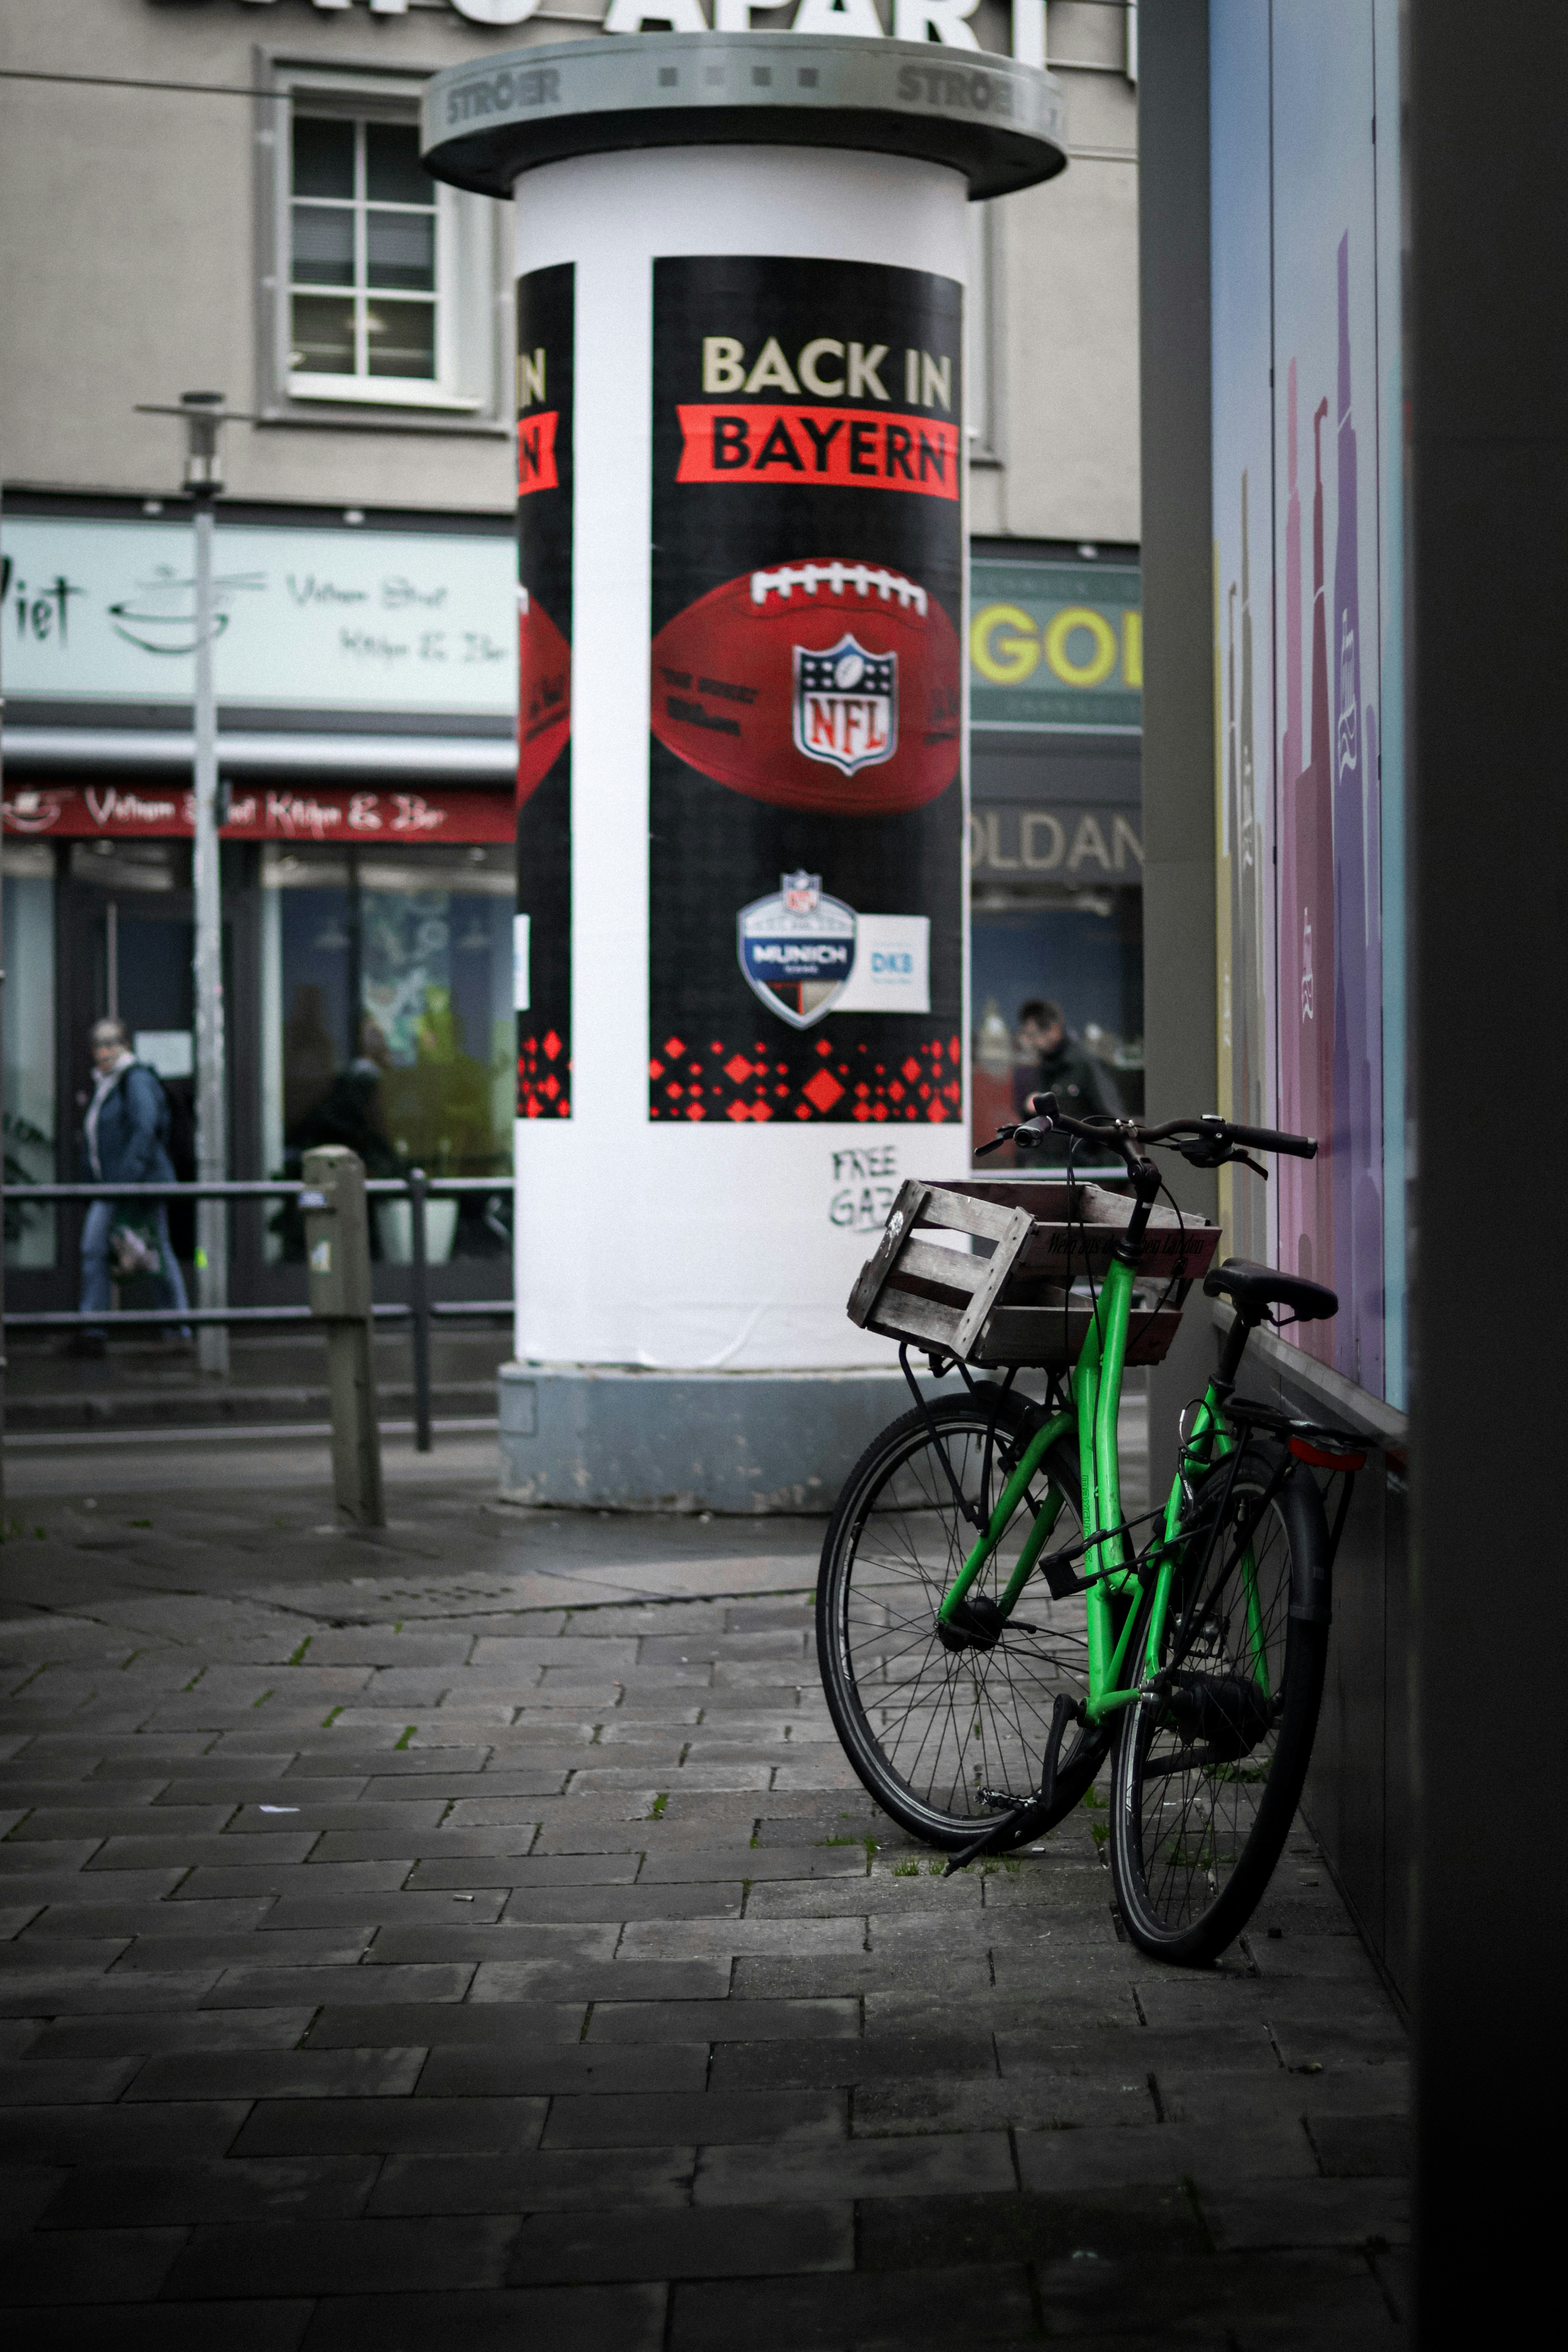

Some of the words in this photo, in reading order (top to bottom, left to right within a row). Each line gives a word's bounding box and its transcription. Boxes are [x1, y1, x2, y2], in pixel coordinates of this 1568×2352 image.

[702, 337, 890, 400] BACK
[905, 349, 952, 411] IN
[712, 416, 946, 485] BAYERN
[0, 555, 85, 648] iet
[810, 697, 886, 754] NFL
[753, 945, 847, 963] MUNICH
[832, 1145, 897, 1181] FREE
[1183, 1480, 1193, 1499] DEORE
